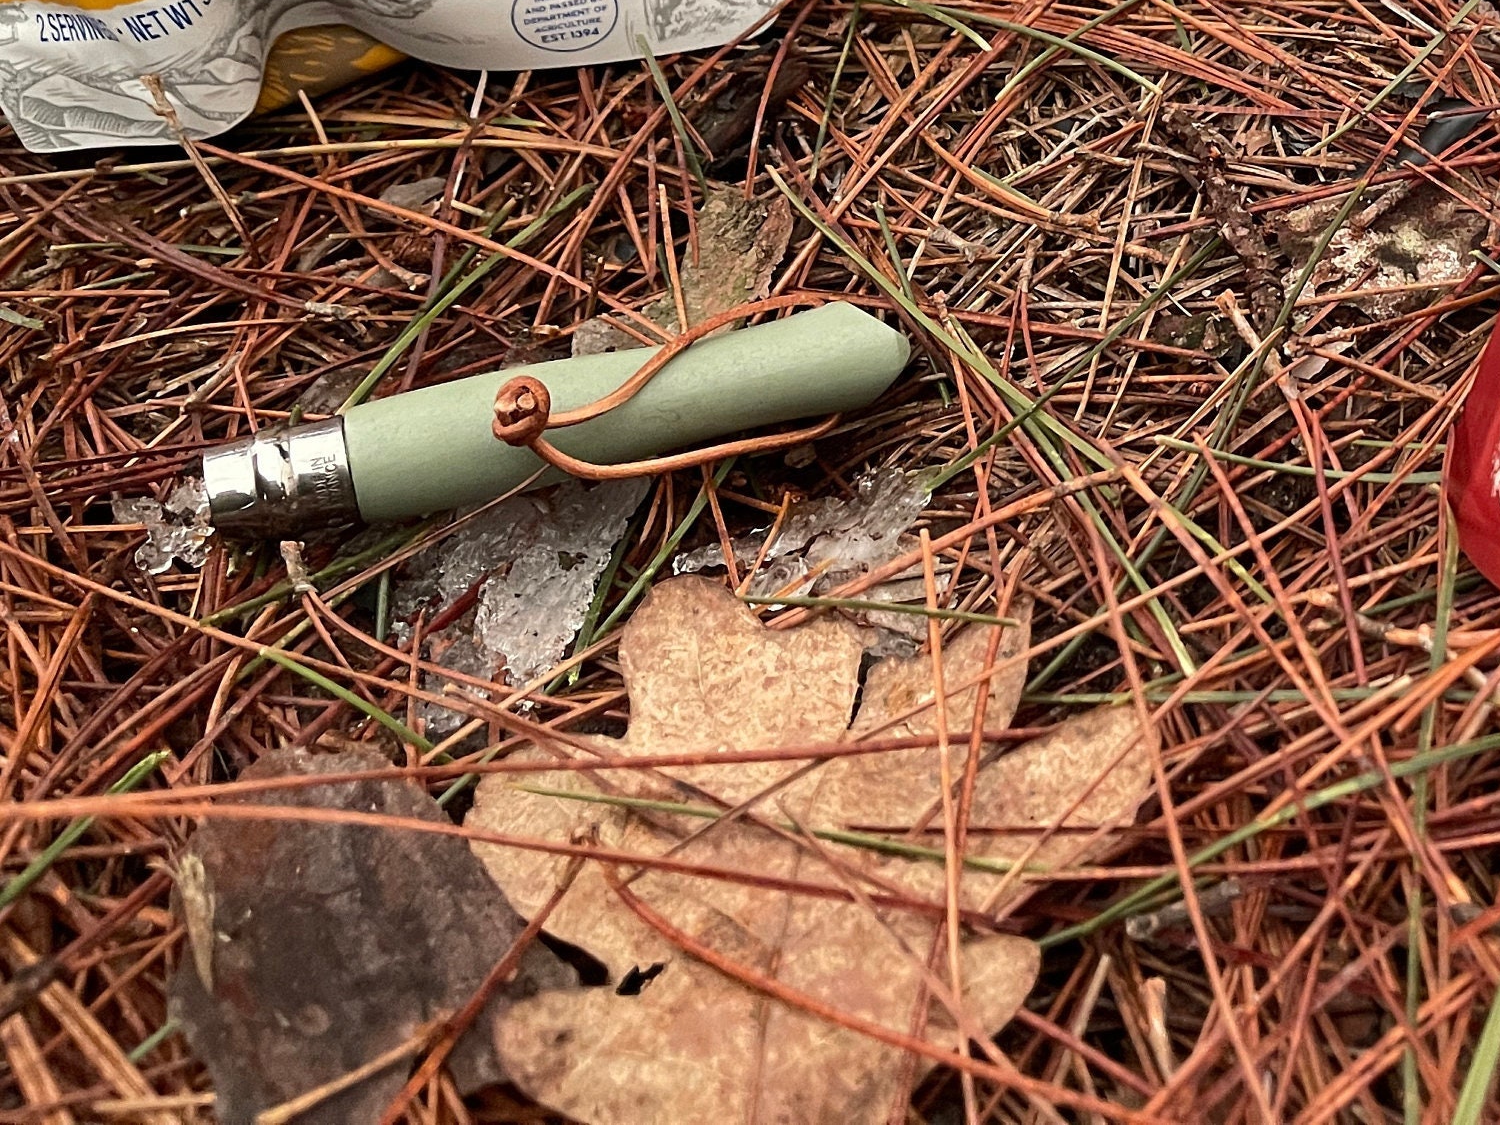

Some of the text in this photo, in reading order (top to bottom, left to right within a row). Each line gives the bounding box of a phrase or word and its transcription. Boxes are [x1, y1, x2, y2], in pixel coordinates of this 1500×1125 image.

[523, 5, 607, 25] DEPARTMENT OF
[525, 5, 546, 14] AND
[36, 13, 48, 42] 2
[122, 10, 164, 43] NET
[534, 17, 602, 33] AGRICULTURE
[571, 27, 600, 39] 1394
